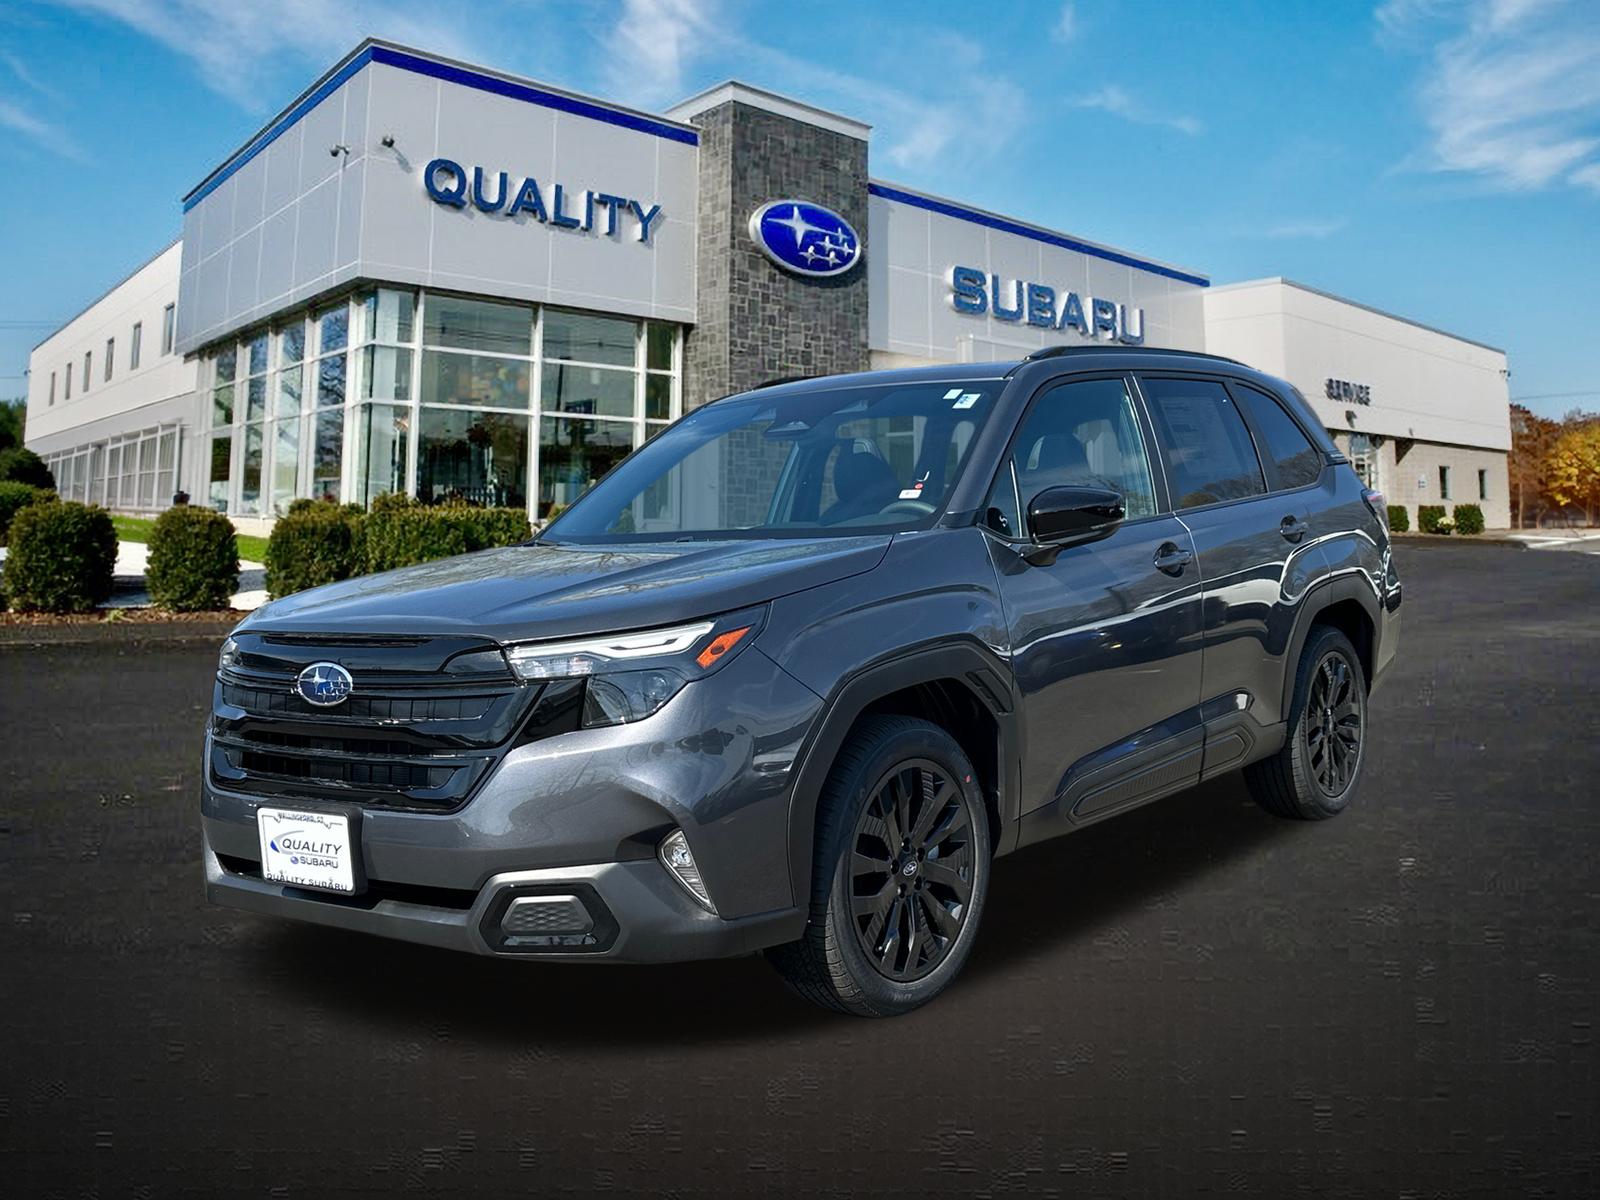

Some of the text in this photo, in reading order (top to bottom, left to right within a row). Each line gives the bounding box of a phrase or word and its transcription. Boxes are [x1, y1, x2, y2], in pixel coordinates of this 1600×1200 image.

[424, 158, 661, 242] QUALITY
[951, 265, 1145, 346] SUBARU
[282, 838, 342, 855] QUALITY
[299, 856, 339, 869] SUBARU
[266, 873, 305, 885] QUALITY
